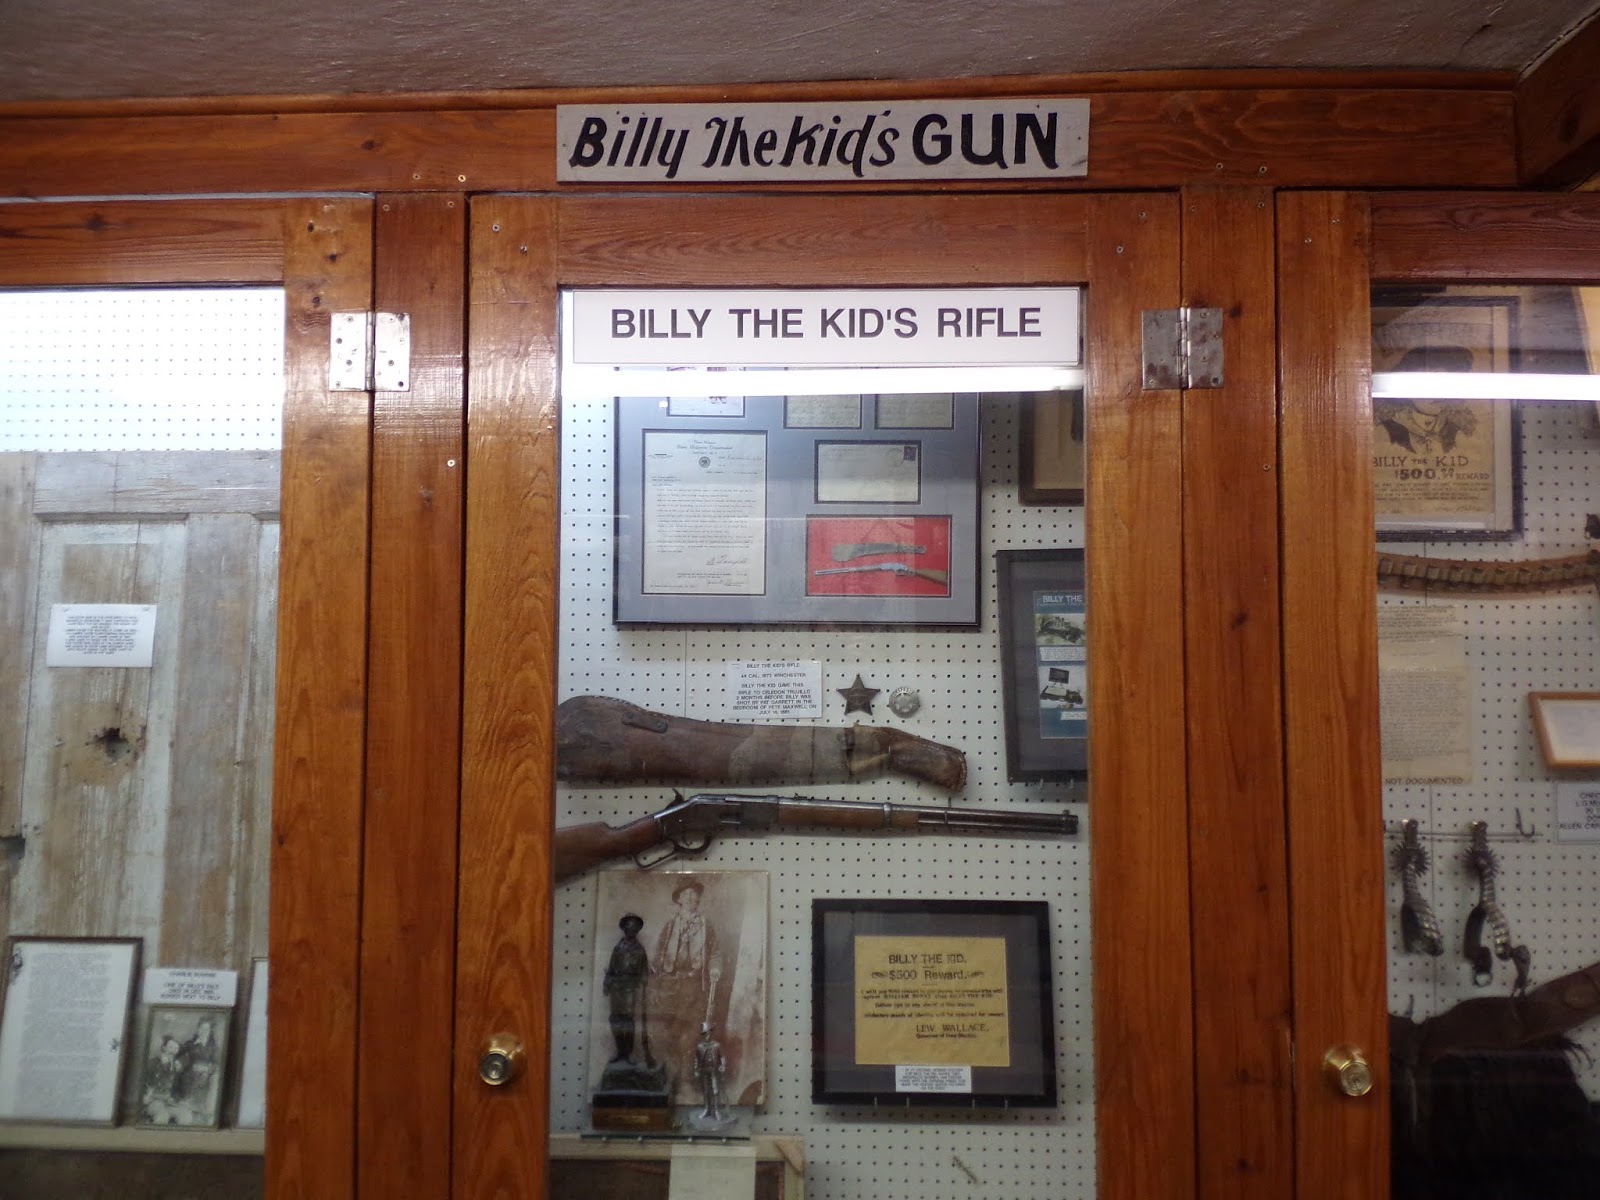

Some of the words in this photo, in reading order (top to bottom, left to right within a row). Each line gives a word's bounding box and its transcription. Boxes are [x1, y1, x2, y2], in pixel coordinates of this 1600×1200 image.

[569, 110, 689, 178] Billy
[703, 116, 777, 168] The
[780, 110, 899, 177] Kid's
[913, 112, 1059, 169] GUN
[612, 308, 711, 339] BILLY
[729, 308, 804, 339] THE
[821, 308, 918, 339] KID'S
[938, 308, 1041, 339] RIFLE
[1374, 456, 1407, 467] BILLY
[1436, 456, 1469, 467] KID
[1043, 595, 1063, 603] BILLY
[1066, 595, 1082, 603] THE
[889, 954, 918, 964] BILLY
[921, 954, 942, 964] THE
[889, 969, 917, 980] $500
[924, 969, 967, 980] Reward.
[916, 1024, 934, 1032] LEW
[942, 1024, 989, 1032] WALLACE.
